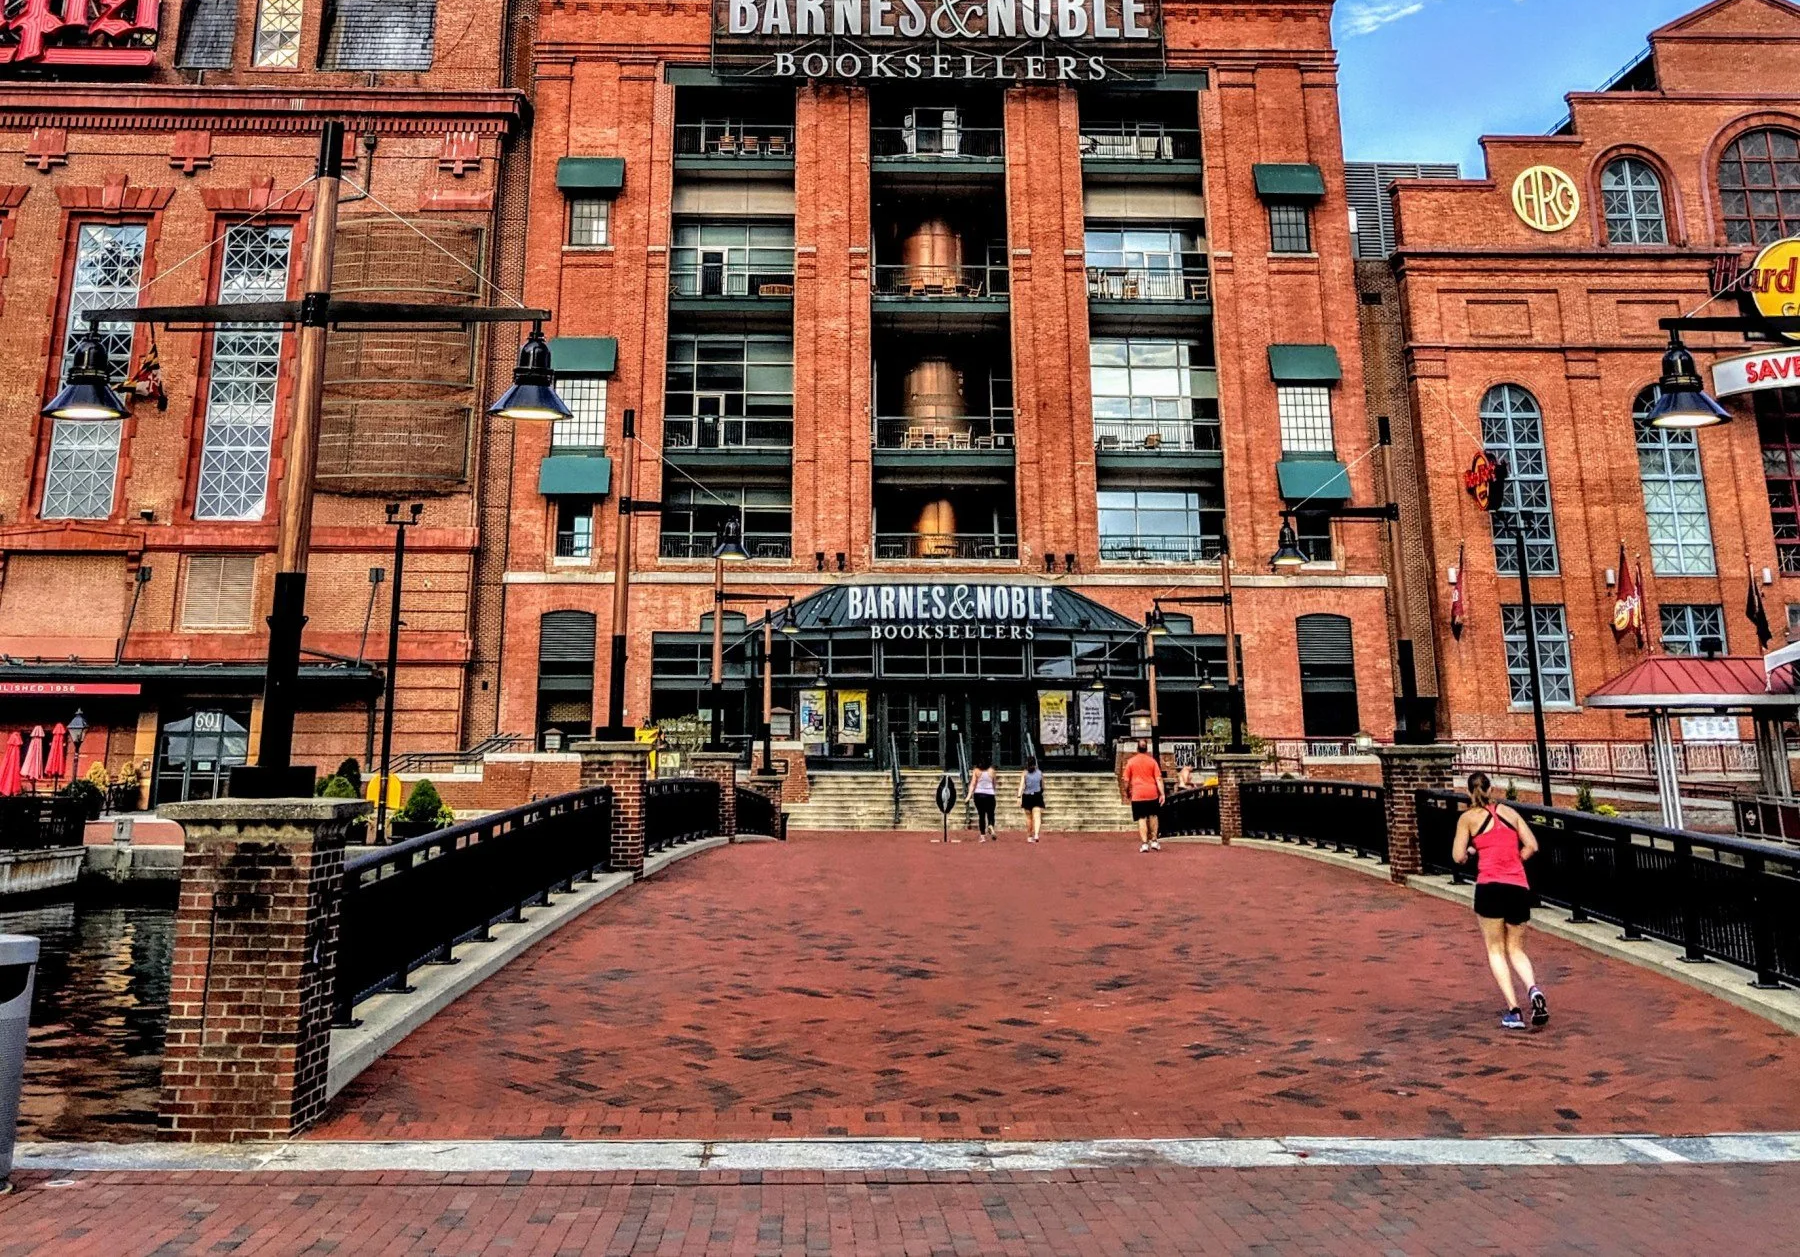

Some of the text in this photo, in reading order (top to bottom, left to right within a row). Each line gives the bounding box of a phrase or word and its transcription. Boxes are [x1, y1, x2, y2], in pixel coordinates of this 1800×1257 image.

[773, 52, 1107, 80] BOOKSELLERS
[1713, 255, 1799, 294] Hard
[871, 624, 1035, 640] BOOKSELLERS
[0, 684, 76, 693] LISHED 1956
[195, 712, 221, 728] 601
